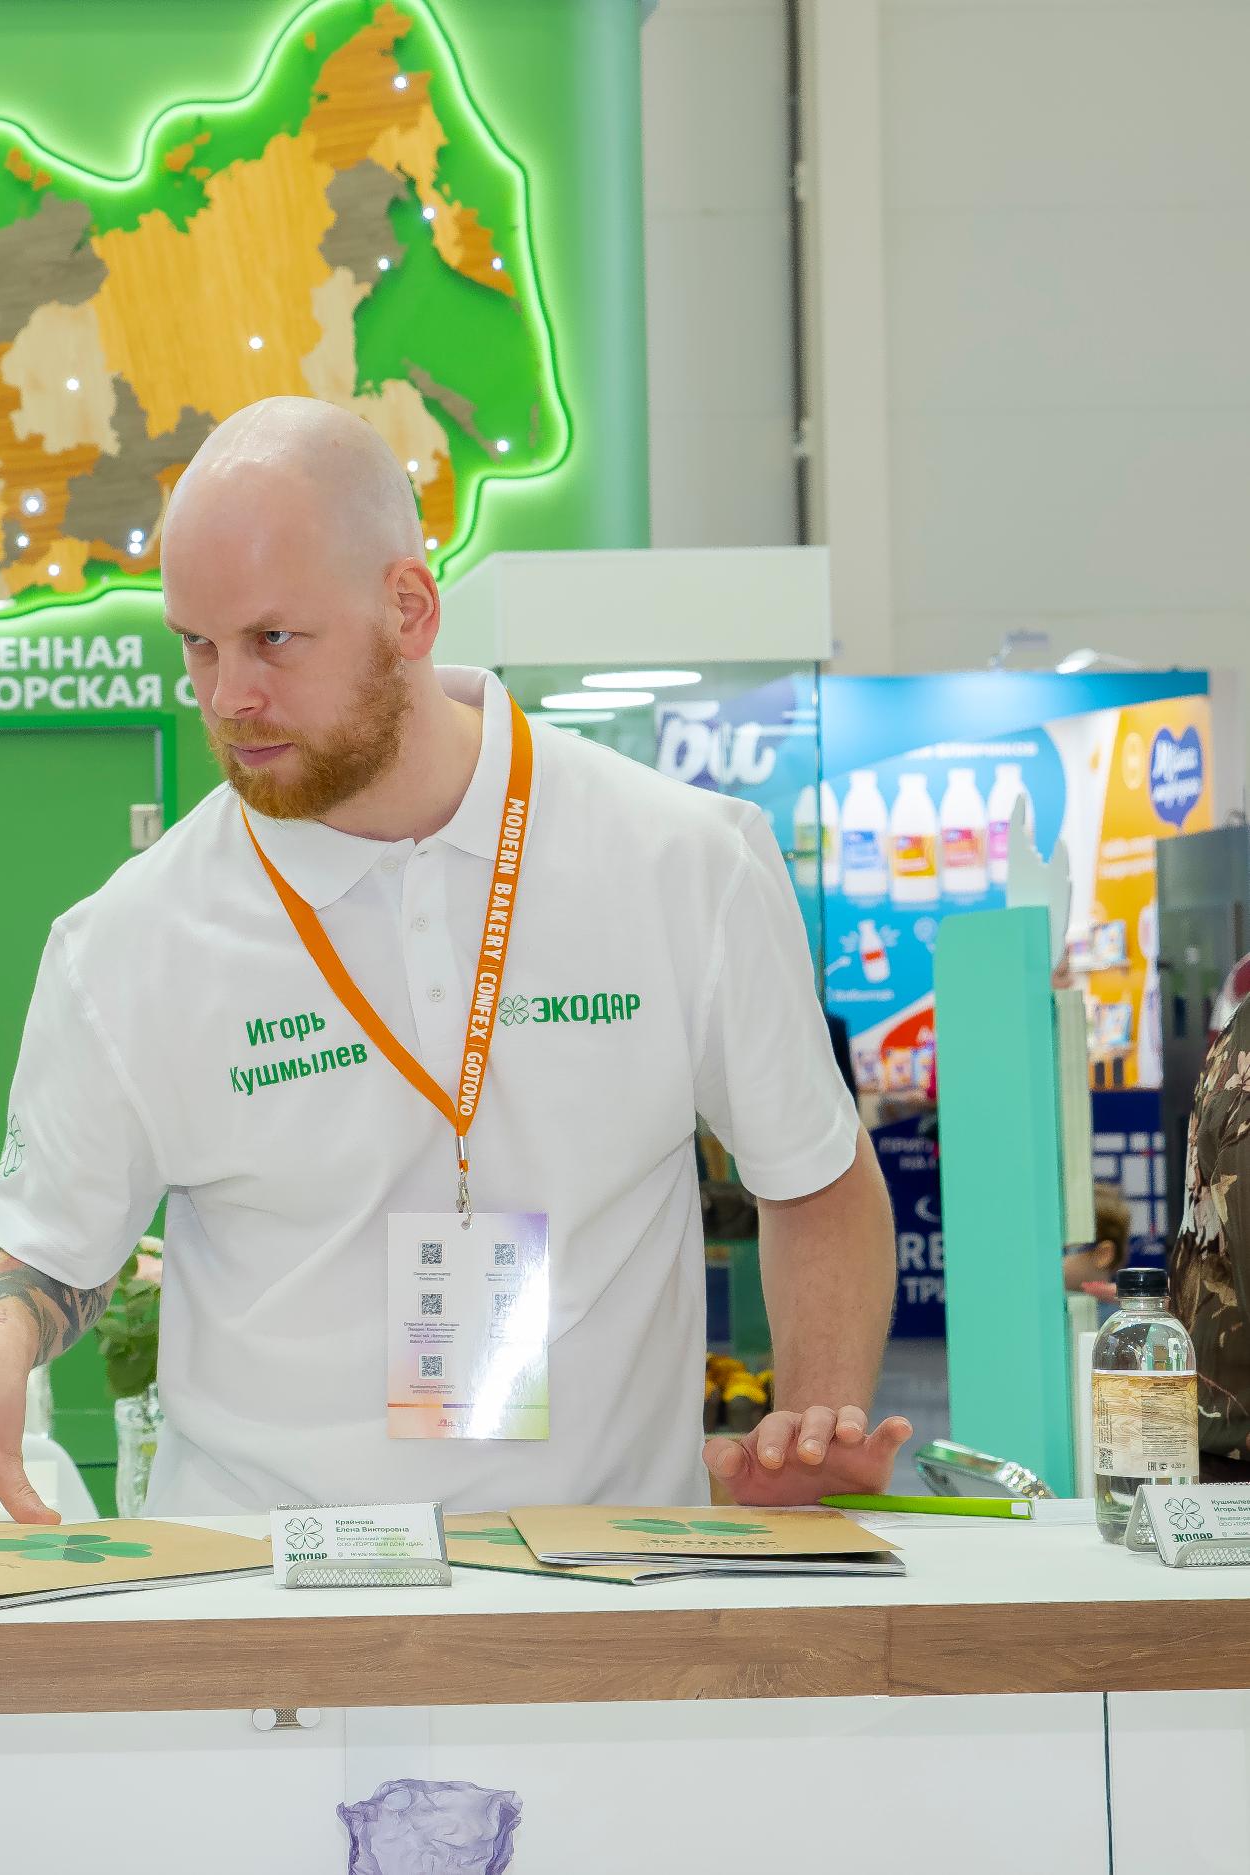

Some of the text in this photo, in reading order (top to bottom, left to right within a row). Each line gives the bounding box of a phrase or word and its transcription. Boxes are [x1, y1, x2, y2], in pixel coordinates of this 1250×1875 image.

[459, 798, 525, 1117] MODERN BAKERY CONFEX GOTOVO
[245, 1009, 327, 1048] Игорь
[531, 993, 641, 1025] ЭКОДАР
[229, 1042, 368, 1096] Кушмылев
